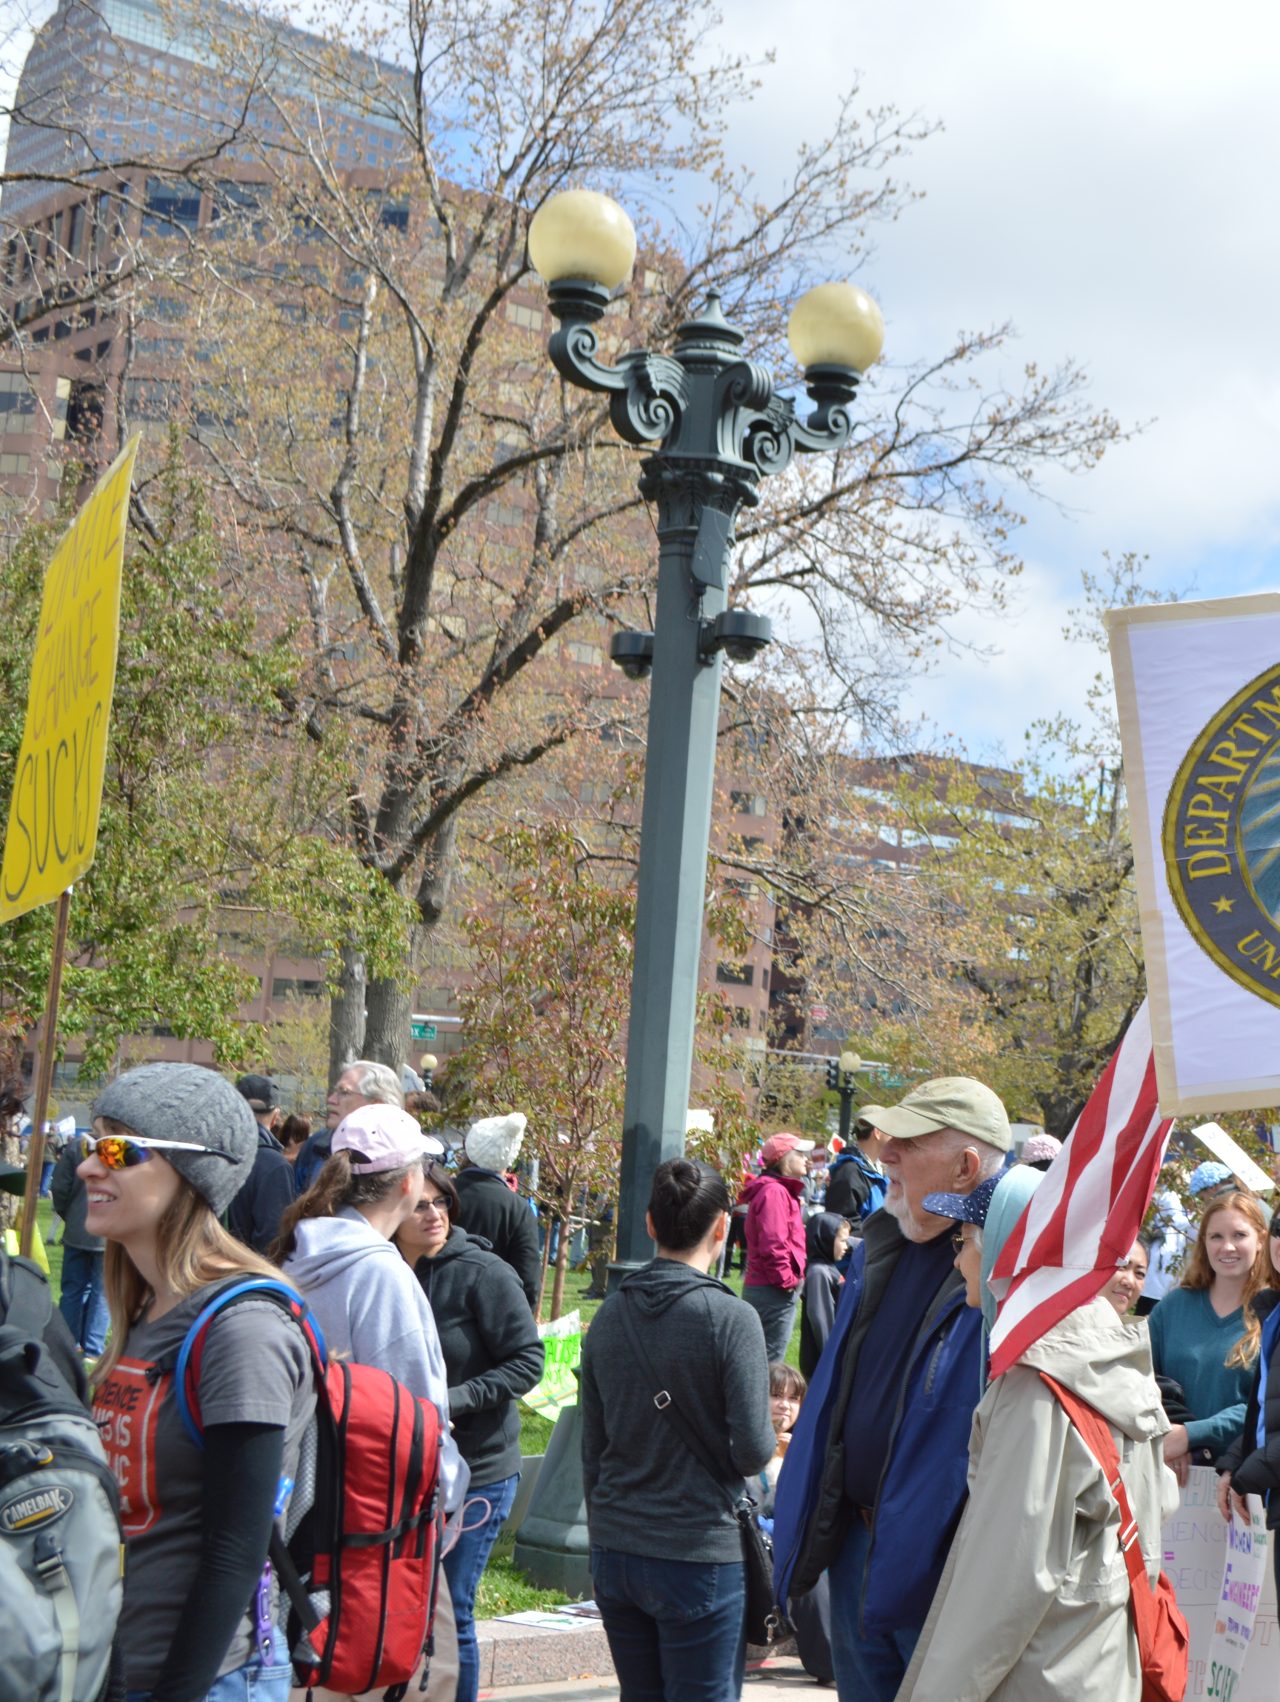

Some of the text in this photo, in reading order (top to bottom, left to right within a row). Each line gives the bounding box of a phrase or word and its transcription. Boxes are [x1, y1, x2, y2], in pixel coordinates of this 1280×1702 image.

[34, 588, 101, 740] CHANGE
[4, 701, 101, 902] SUCKS
[115, 1413, 132, 1447] IS
[3, 1488, 65, 1530] CAMELBAK
